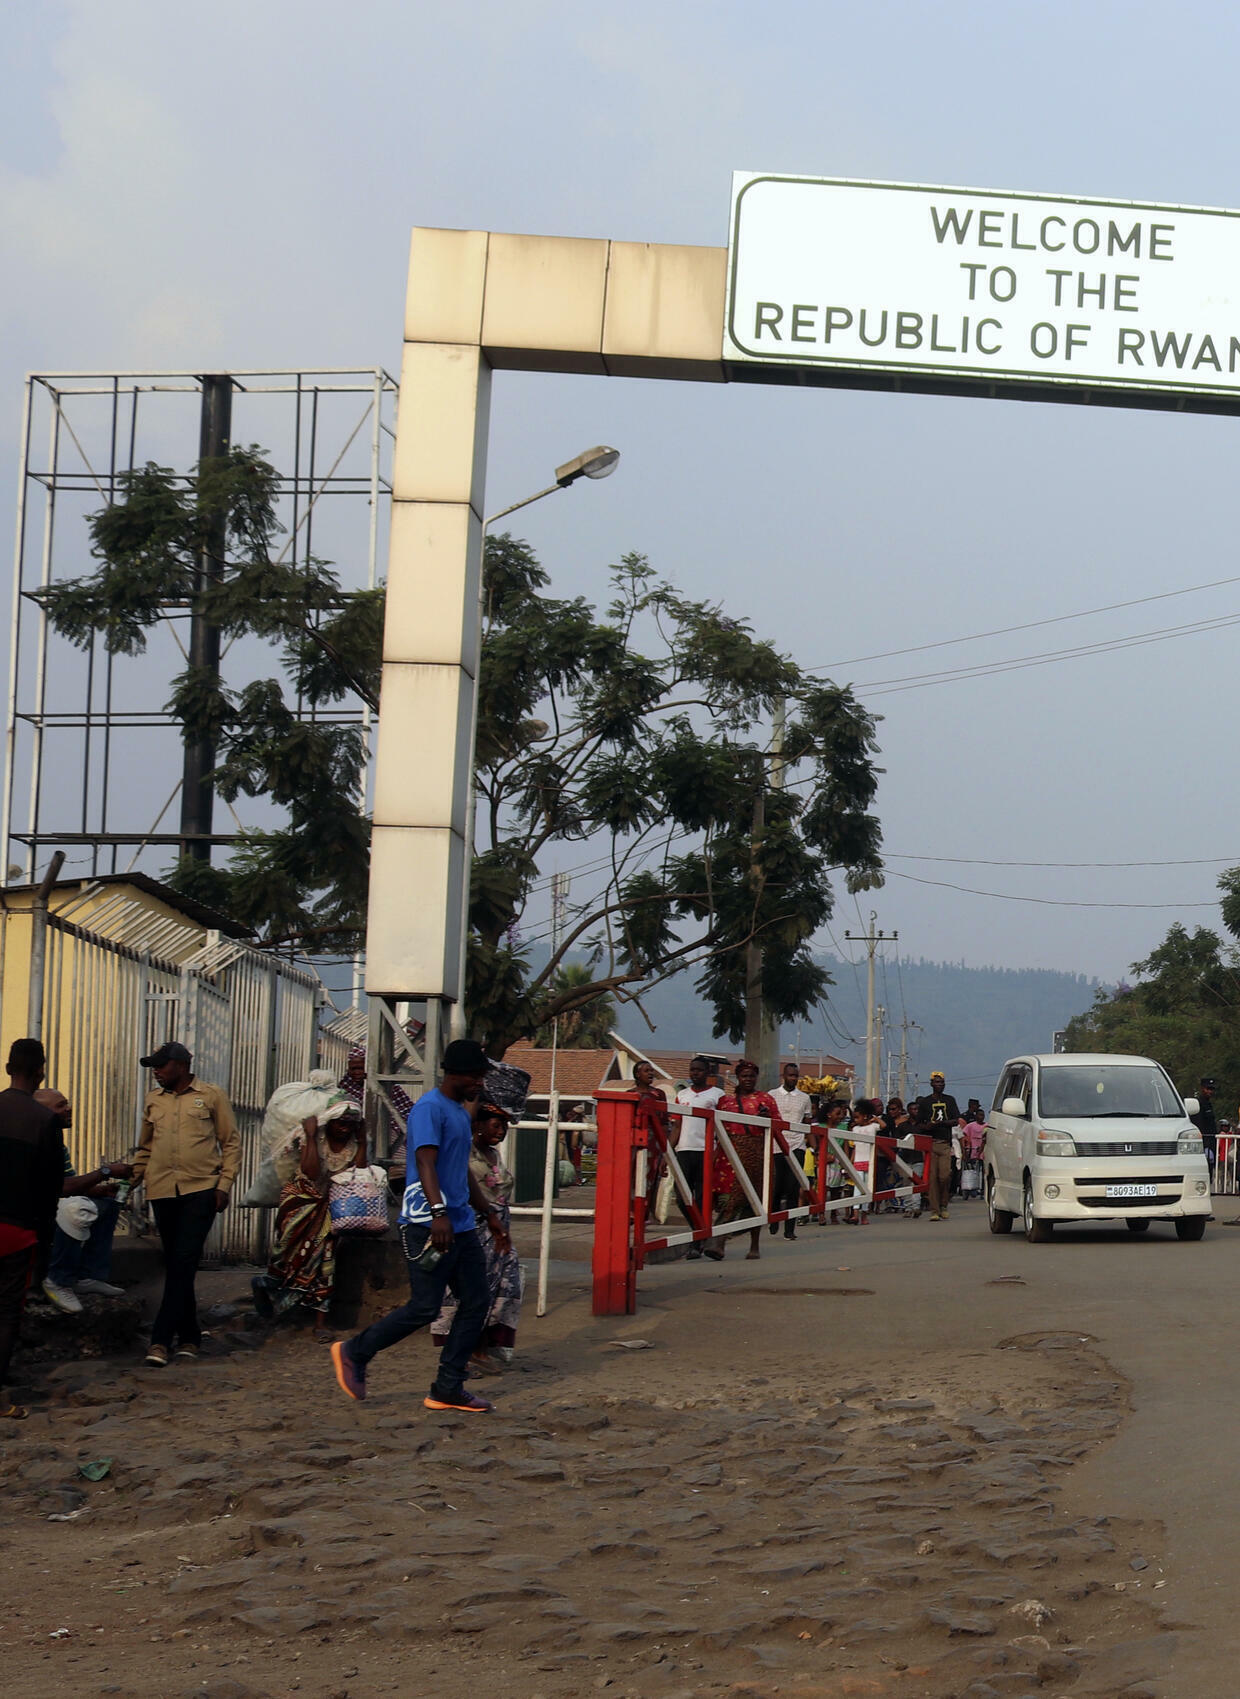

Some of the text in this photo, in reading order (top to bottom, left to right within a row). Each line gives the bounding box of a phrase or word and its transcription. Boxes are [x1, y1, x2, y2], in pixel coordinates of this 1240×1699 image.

[931, 207, 1175, 261] WELCOME
[960, 263, 1139, 312] TO THE
[755, 302, 1002, 355] REPUBLIC
[1031, 322, 1091, 360] OF
[1146, 1186, 1156, 1195] 19
